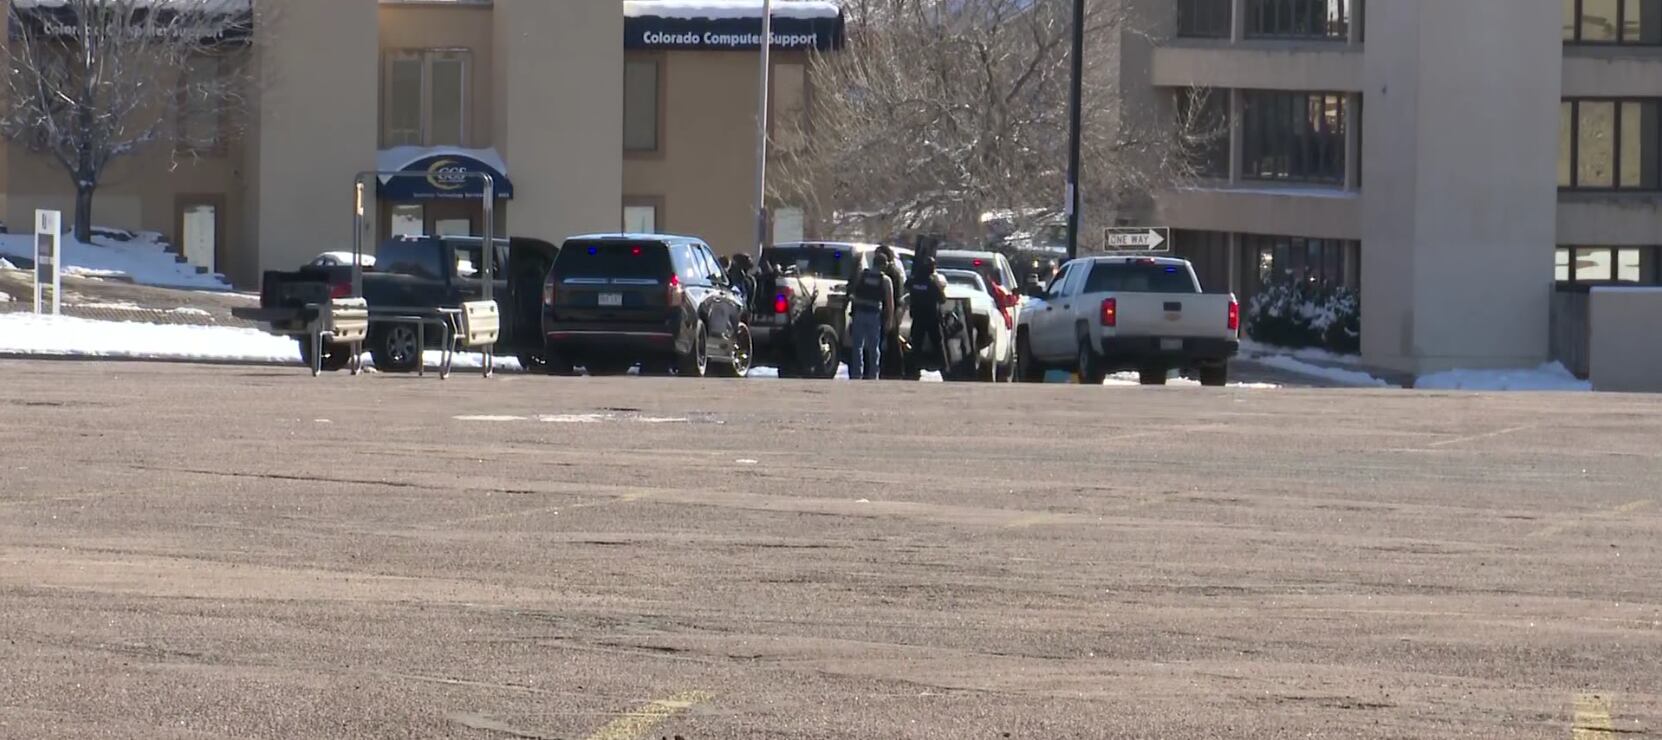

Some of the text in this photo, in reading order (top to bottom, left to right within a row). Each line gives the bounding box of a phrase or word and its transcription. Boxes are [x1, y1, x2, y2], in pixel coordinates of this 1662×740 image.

[643, 31, 700, 44] Colorado
[769, 32, 817, 47] Support
[1111, 235, 1149, 244] ONE WAY
